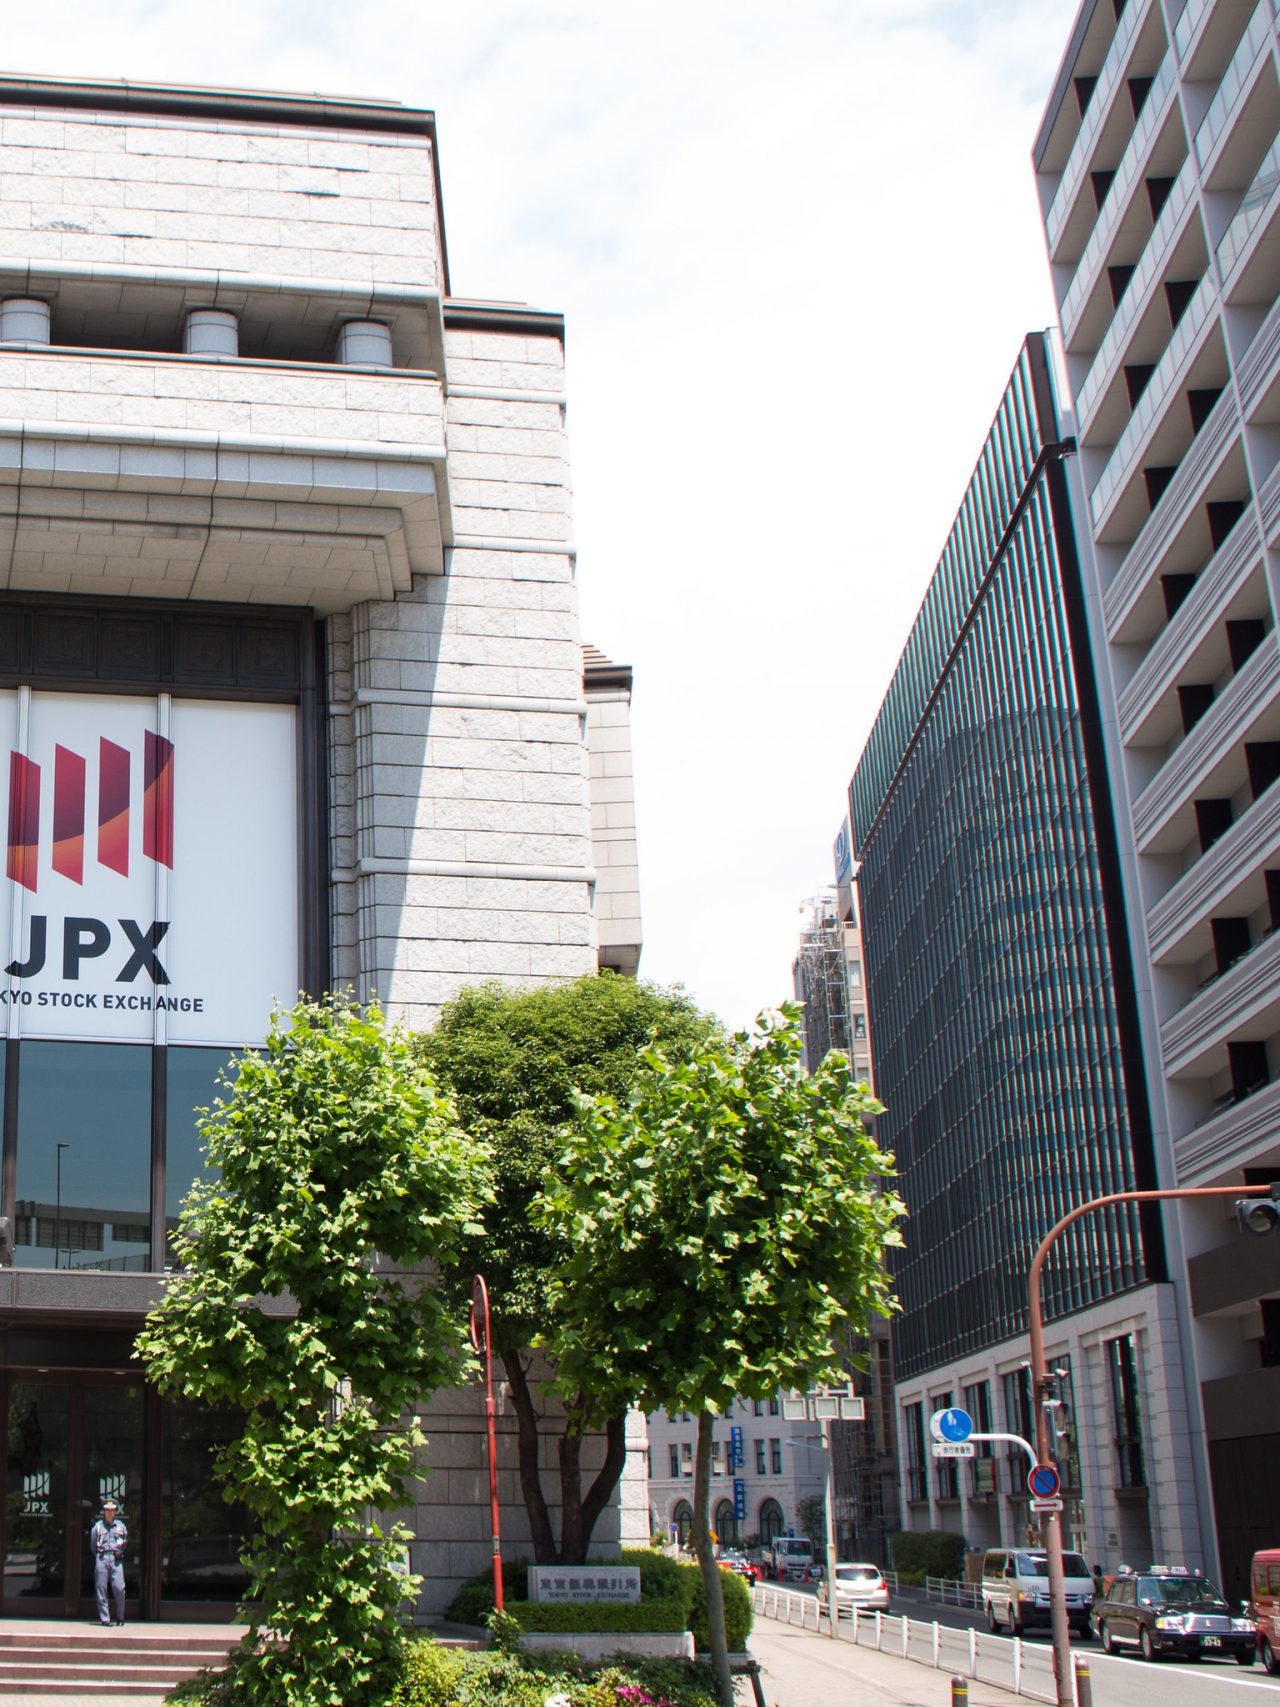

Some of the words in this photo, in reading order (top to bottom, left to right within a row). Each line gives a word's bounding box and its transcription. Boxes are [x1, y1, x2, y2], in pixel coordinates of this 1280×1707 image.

[4, 915, 172, 985] JPX
[37, 992, 97, 1008] STOCK
[103, 994, 204, 1013] EXCHANGE
[24, 1502, 49, 1513] JPX
